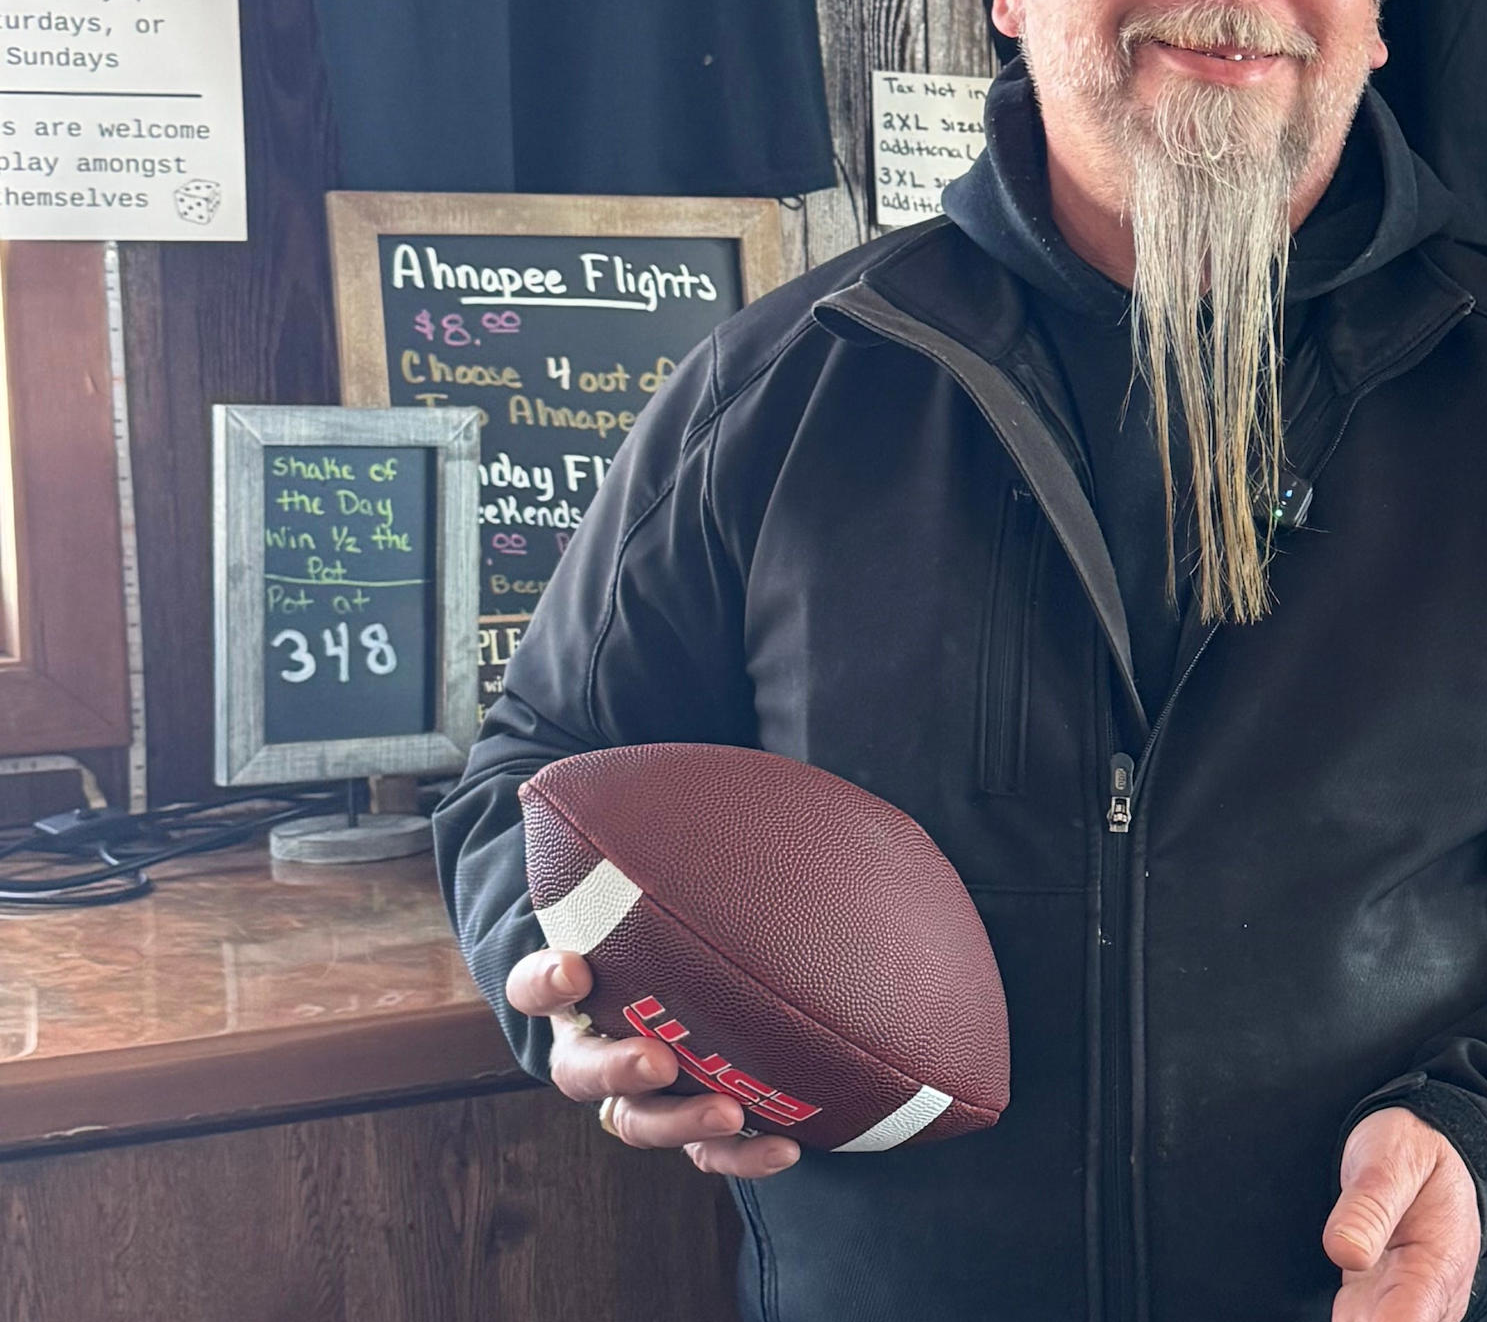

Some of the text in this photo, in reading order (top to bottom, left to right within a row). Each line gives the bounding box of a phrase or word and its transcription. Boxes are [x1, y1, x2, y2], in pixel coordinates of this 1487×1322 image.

[135, 17, 165, 34] or
[6, 47, 120, 72] Sundays
[882, 77, 915, 94] Tax
[924, 83, 957, 97] Not
[34, 120, 82, 138] are
[98, 118, 210, 140] welcome
[882, 112, 929, 131] 2XL
[76, 156, 187, 177] amongst
[879, 167, 926, 188] 3XL
[0, 188, 150, 209] hemselves
[393, 243, 717, 312] Ahnapee Flights
[401, 349, 523, 389] Choose
[545, 356, 571, 391] 4
[578, 362, 631, 393] out
[369, 457, 399, 482] of
[276, 489, 394, 528] the Day
[266, 526, 316, 551] Win
[371, 524, 413, 552] the
[307, 556, 347, 582] Pot
[267, 584, 371, 614] Pot at
[270, 621, 397, 683] 348
